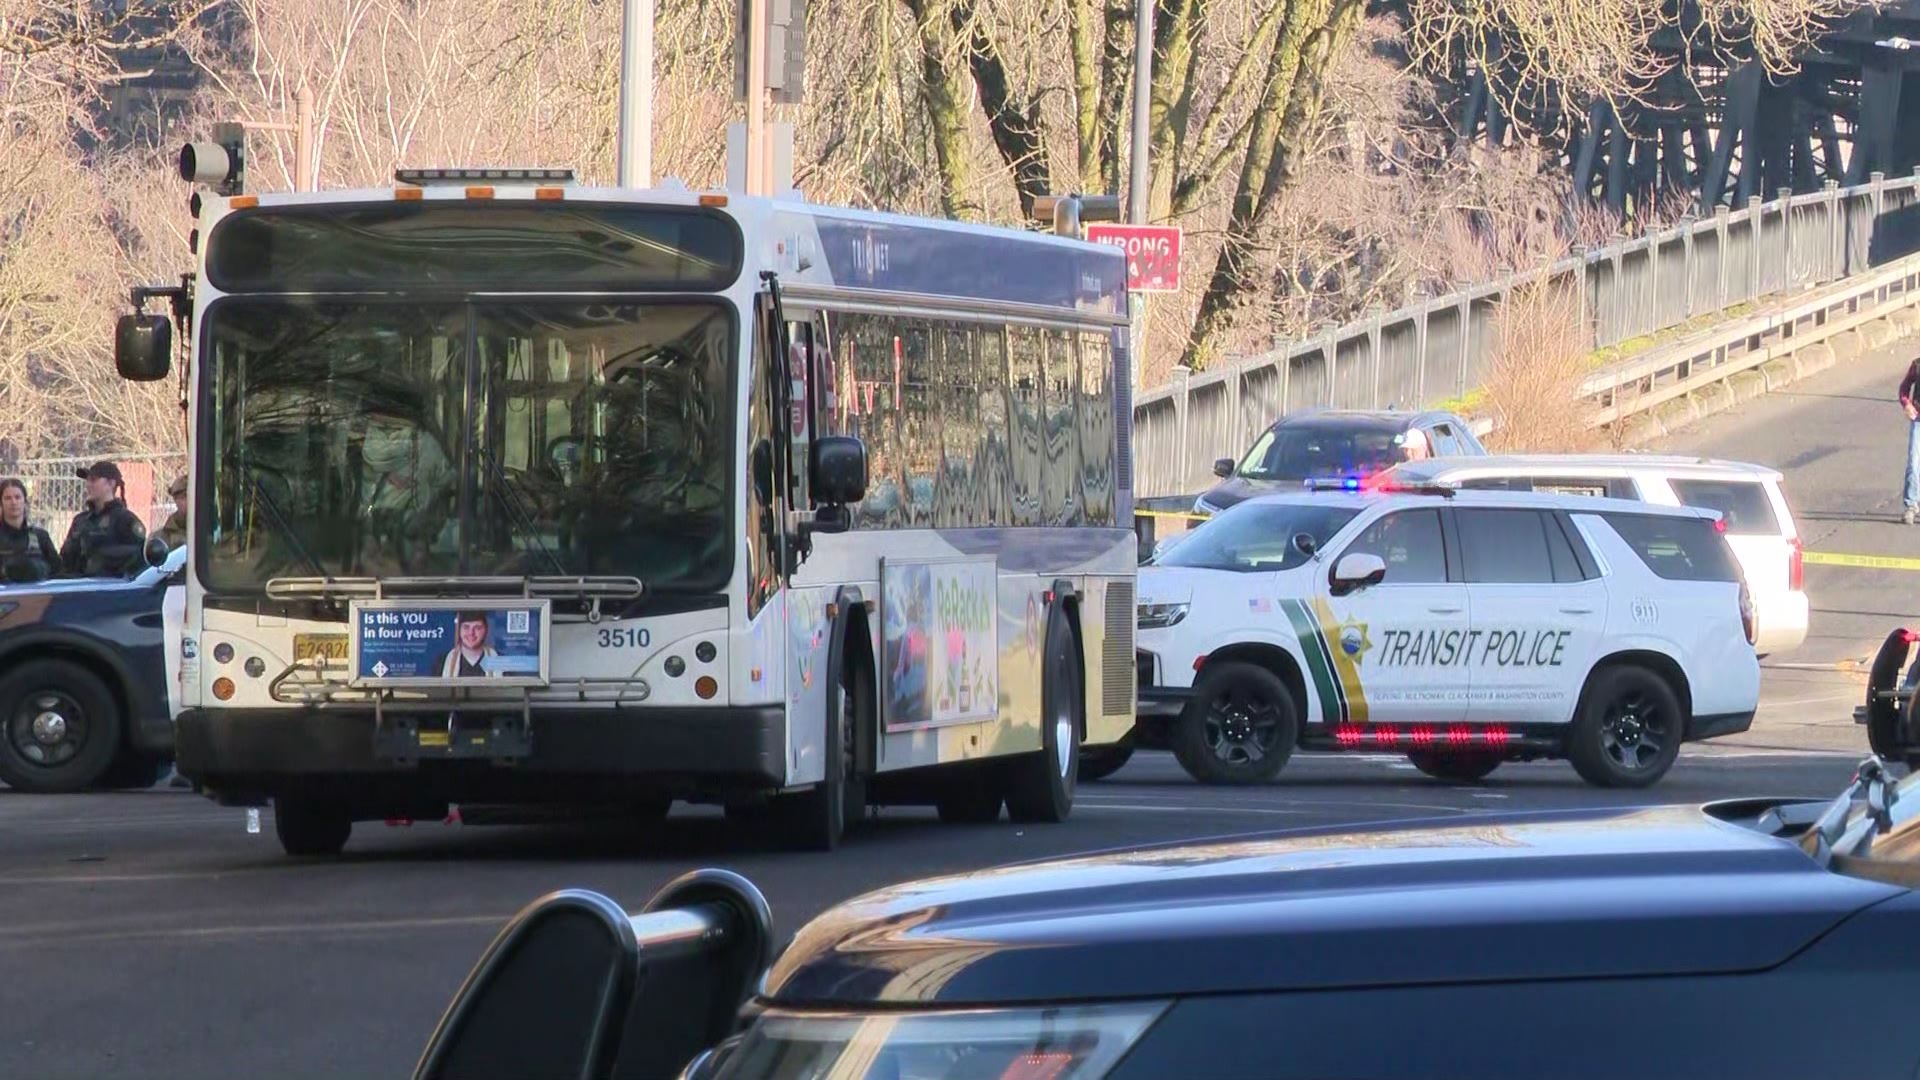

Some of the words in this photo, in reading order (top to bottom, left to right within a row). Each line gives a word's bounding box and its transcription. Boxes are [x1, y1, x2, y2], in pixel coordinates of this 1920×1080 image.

[364, 613, 374, 624] Is
[376, 612, 399, 624] this
[401, 613, 428, 624] YOU
[1635, 605, 1654, 618] 911
[364, 627, 376, 638] in
[378, 627, 403, 638] four
[406, 627, 444, 641] years?
[598, 628, 650, 648] 3510
[1379, 630, 1481, 666] TRANSIT
[1481, 630, 1571, 666] POLICE
